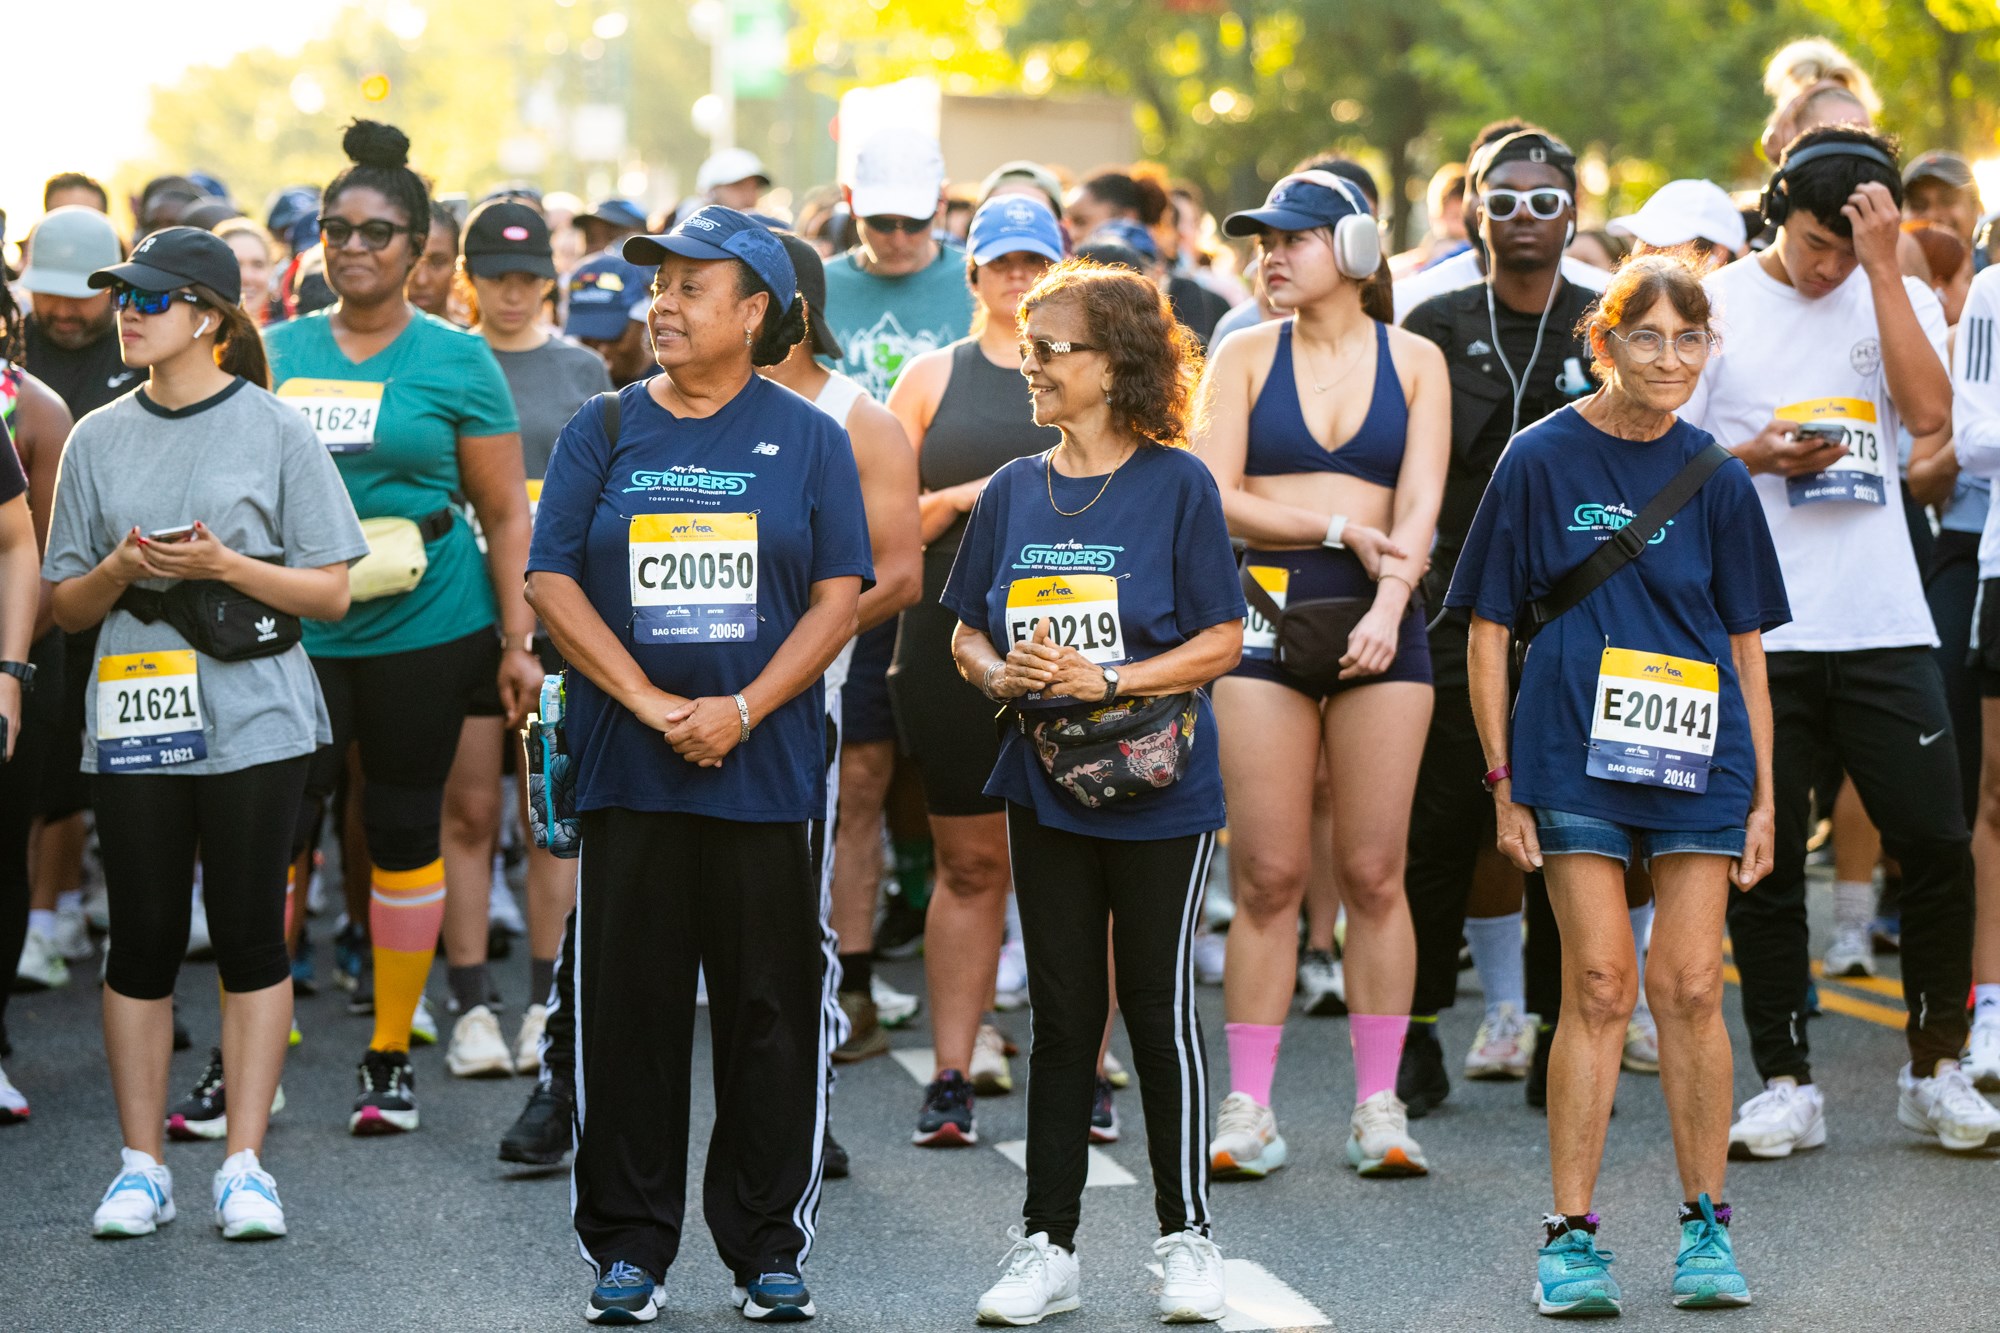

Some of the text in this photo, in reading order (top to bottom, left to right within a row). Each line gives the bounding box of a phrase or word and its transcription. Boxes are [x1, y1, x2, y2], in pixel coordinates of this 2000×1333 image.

[635, 471, 744, 493] STRIDERS
[1022, 547, 1112, 569] STRIDERS
[638, 552, 754, 591] C20050
[652, 623, 745, 639] BAG CHECK 20050
[117, 685, 196, 723] 21621
[1027, 692, 1041, 700] BAG
[1603, 687, 1712, 740] E20141
[160, 747, 195, 765] 21621
[1607, 763, 1696, 789] BAG CHECK 20141
